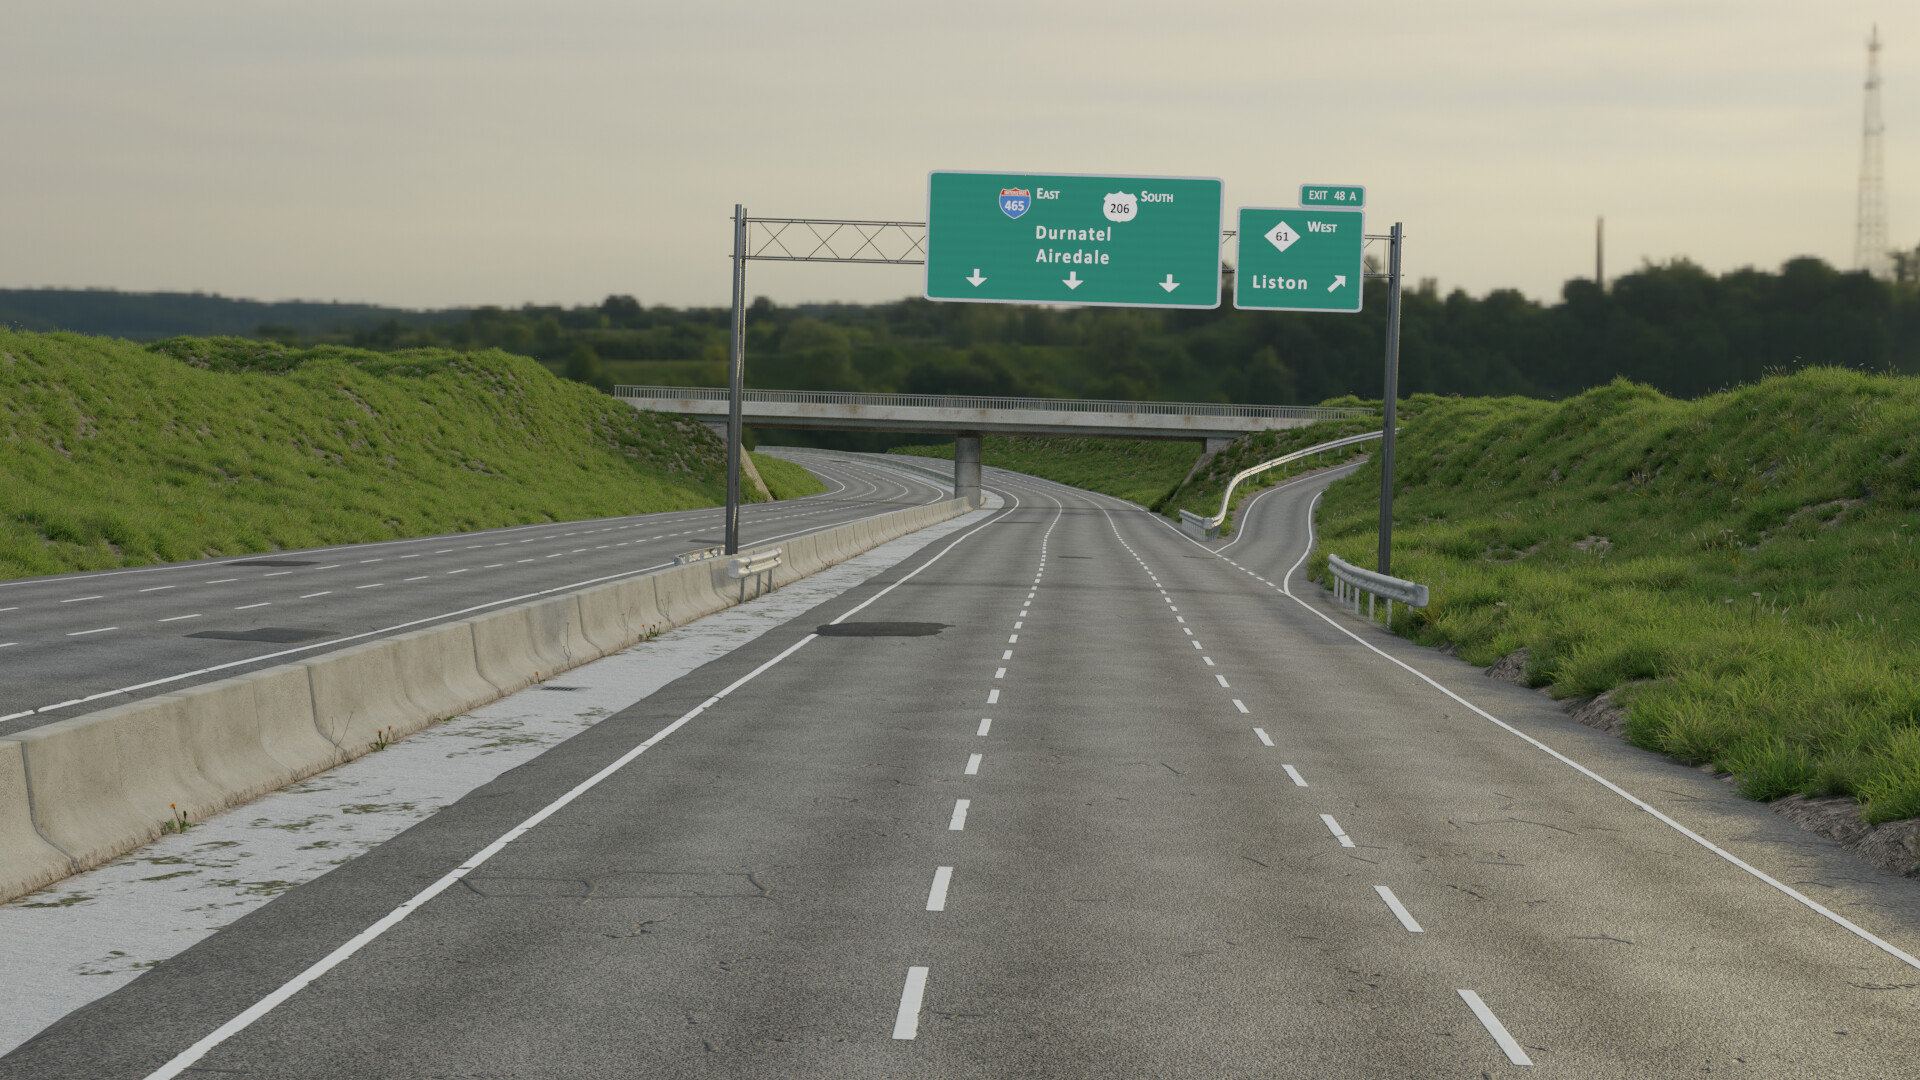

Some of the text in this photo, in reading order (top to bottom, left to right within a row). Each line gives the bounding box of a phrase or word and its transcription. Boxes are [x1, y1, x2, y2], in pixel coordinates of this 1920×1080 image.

[1036, 187, 1061, 200] EAST
[1141, 190, 1174, 203] SOUTH
[1309, 190, 1357, 201] EXIT 48 A
[1004, 200, 1025, 211] 465
[1110, 203, 1130, 214] 206
[1307, 221, 1338, 233] WEST
[1035, 225, 1111, 242] Durnatel
[1275, 231, 1289, 241] 61
[1035, 248, 1110, 265] Airedale
[1252, 274, 1308, 290] Liston
